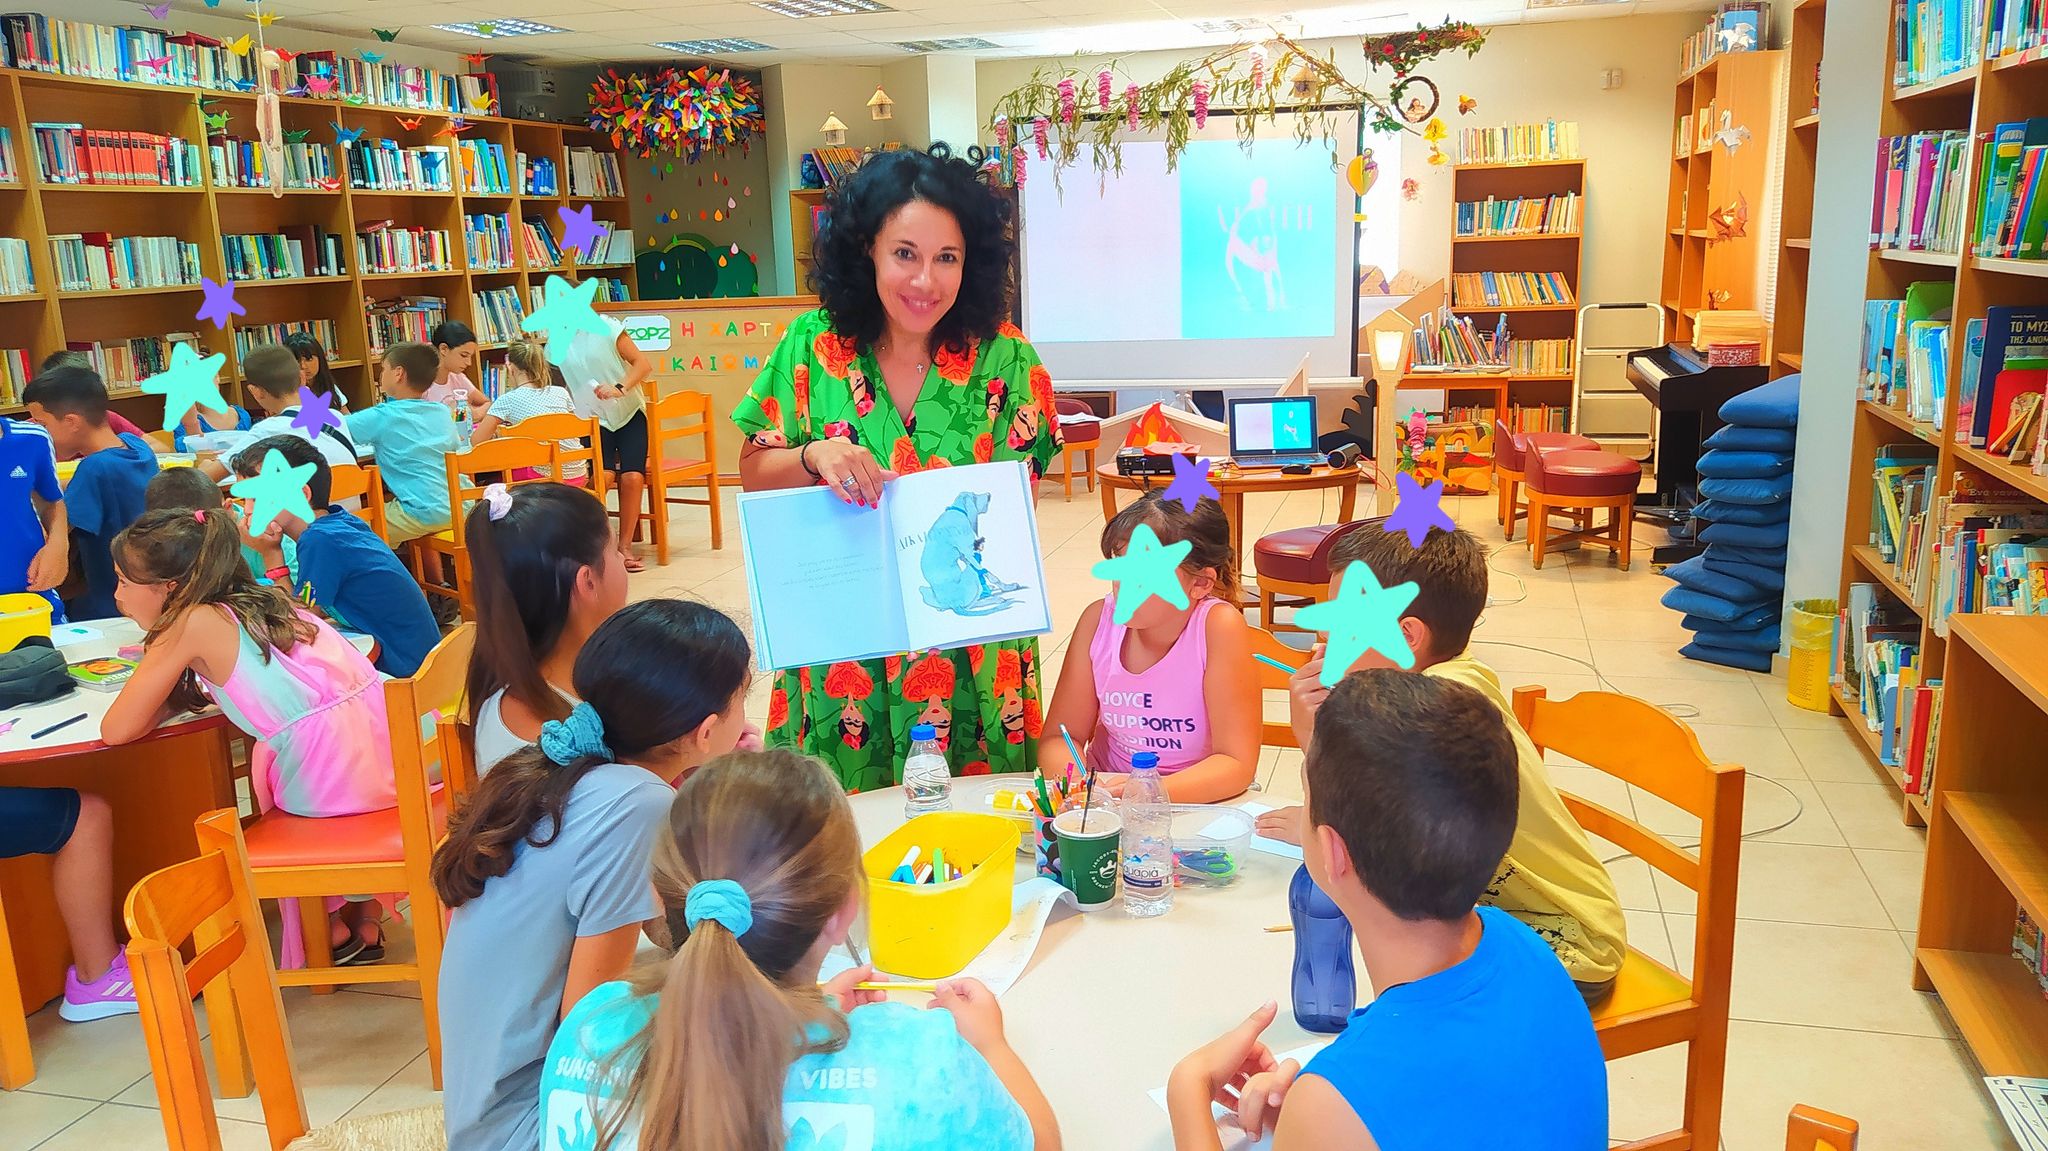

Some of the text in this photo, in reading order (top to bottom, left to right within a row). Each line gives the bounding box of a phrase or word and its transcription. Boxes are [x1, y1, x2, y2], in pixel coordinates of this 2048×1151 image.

[1102, 692, 1153, 708] JOYCE
[1103, 712, 1196, 732] SUPPORTS
[801, 1066, 878, 1091] VIBES
